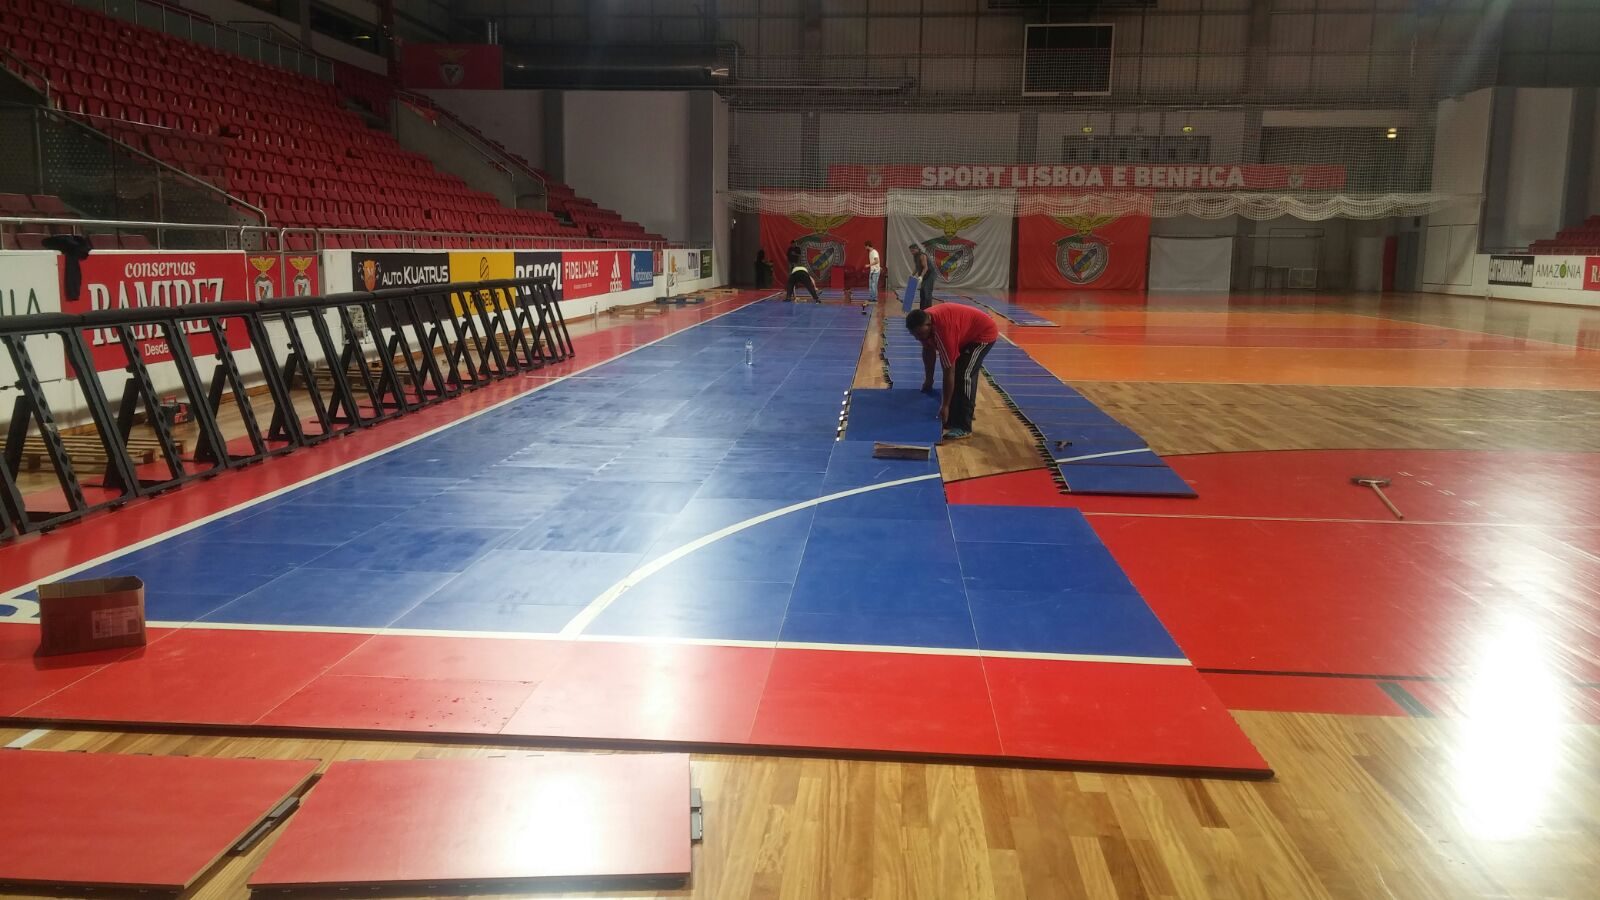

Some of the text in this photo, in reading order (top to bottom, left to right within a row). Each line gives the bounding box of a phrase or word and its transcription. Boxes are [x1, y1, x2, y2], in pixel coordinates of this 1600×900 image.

[921, 166, 1245, 188] SPORT LISBOA E BENFICA
[124, 261, 196, 278] conservas
[382, 265, 449, 286] AUTO KUATRUS
[565, 260, 599, 280] FIDELIDADE
[144, 341, 170, 356] Desde
